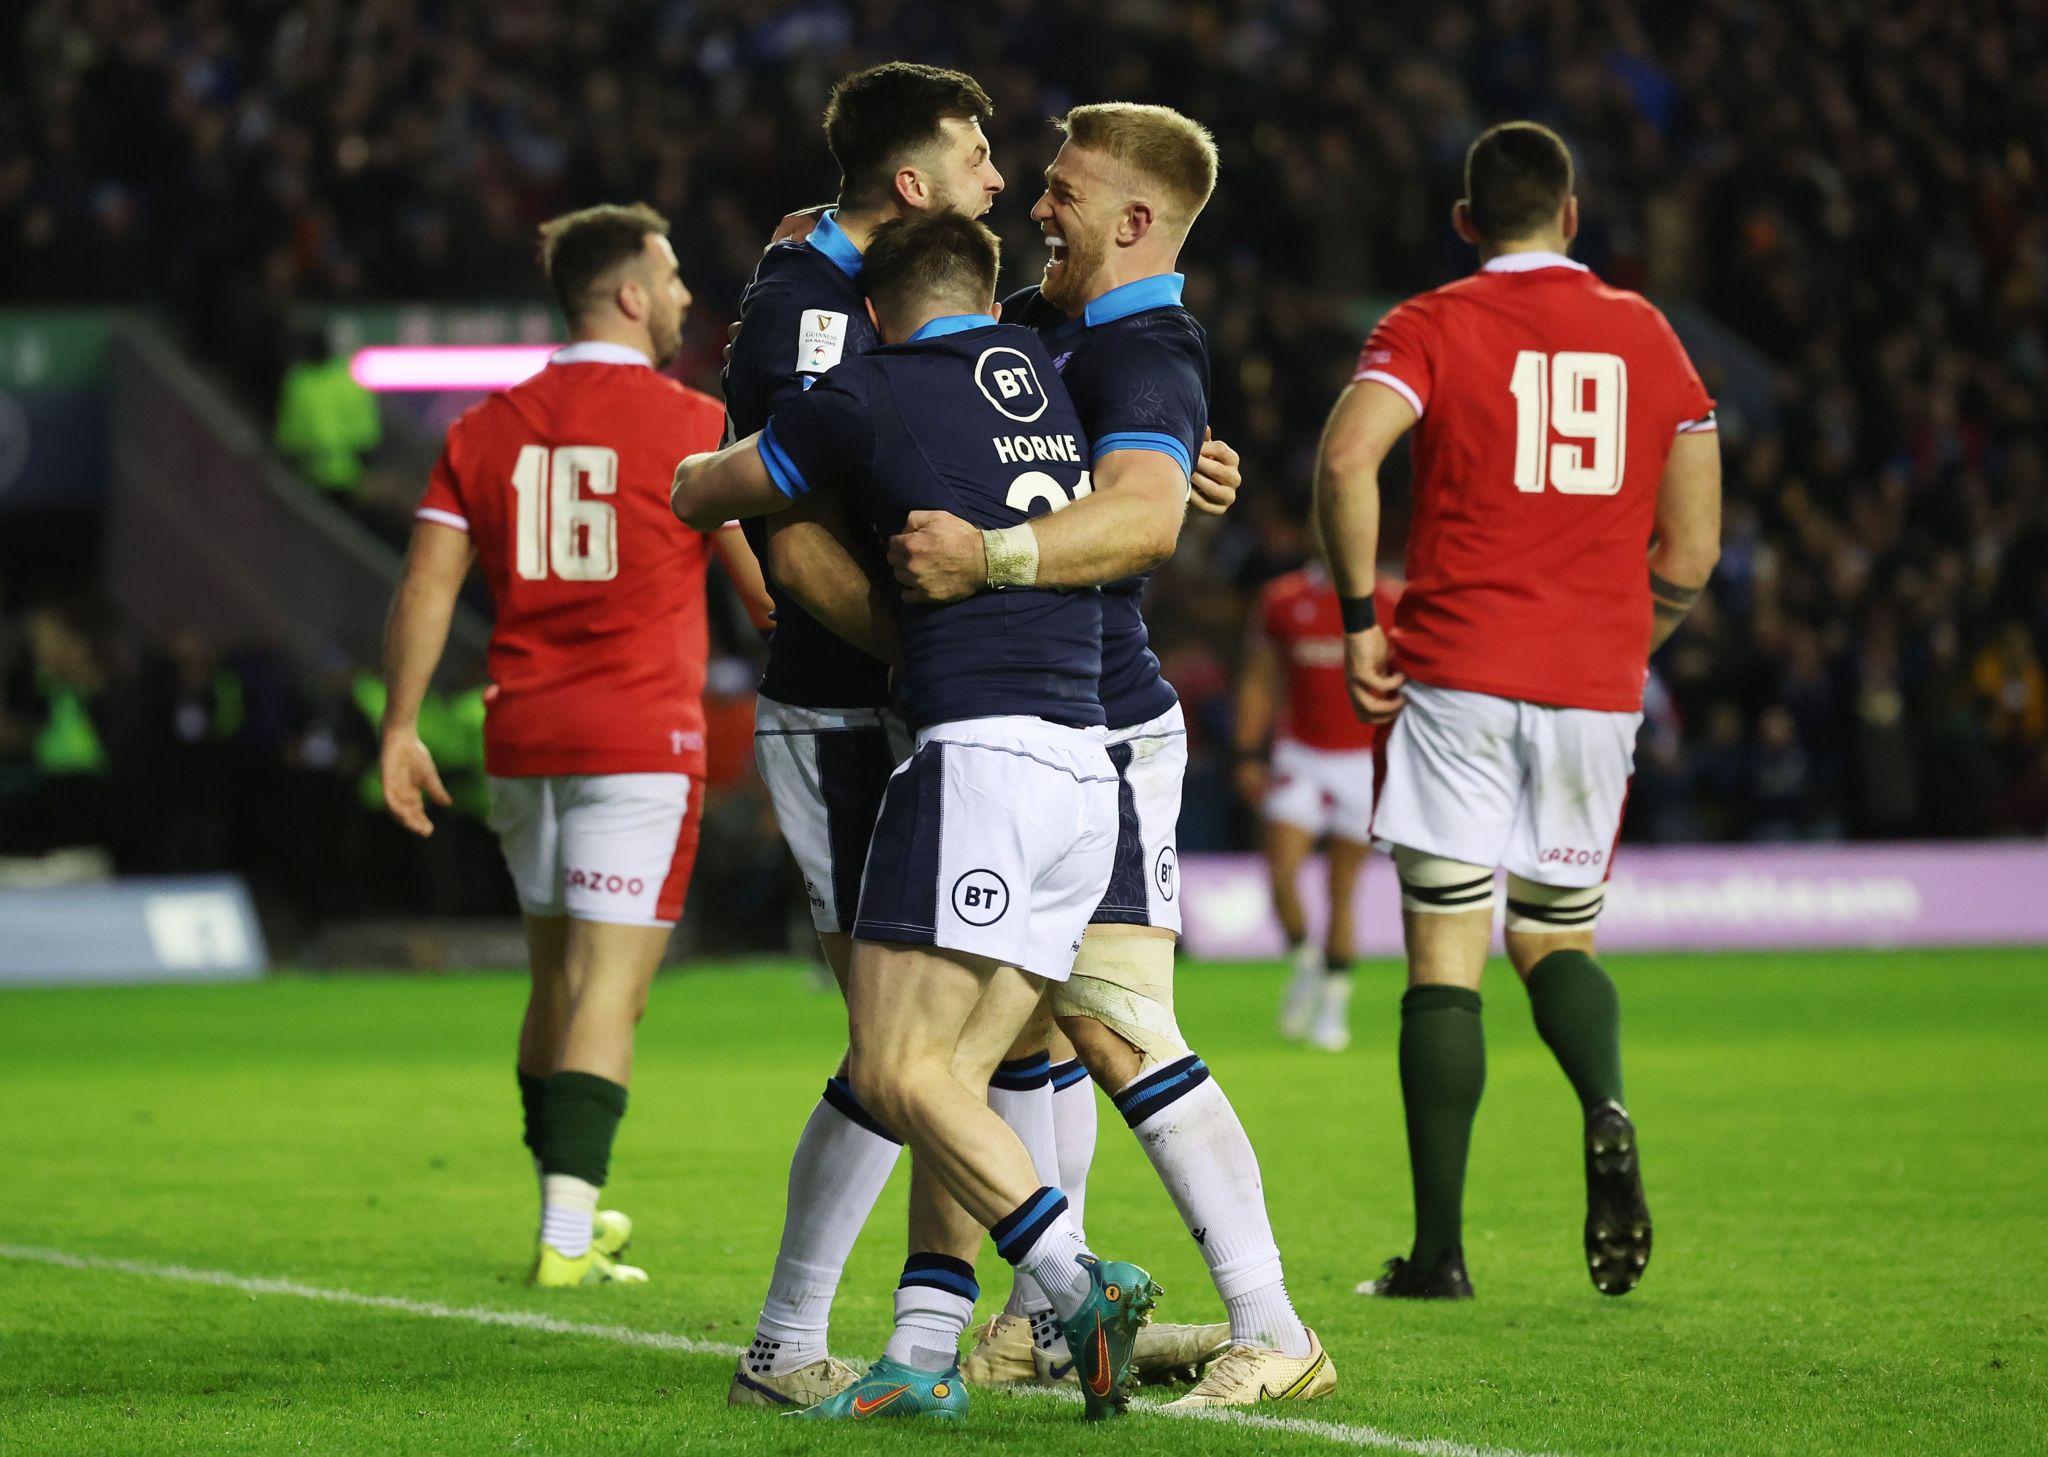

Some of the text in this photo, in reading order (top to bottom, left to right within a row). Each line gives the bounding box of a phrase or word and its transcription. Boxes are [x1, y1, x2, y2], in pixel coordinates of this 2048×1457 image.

[993, 367, 1033, 399] BT
[1509, 350, 1627, 495] 19
[993, 435, 1081, 464] HORNE
[511, 444, 618, 581] 16
[1538, 848, 1603, 865] CAZOO
[1162, 863, 1172, 884] BT
[965, 886, 998, 909] BT
